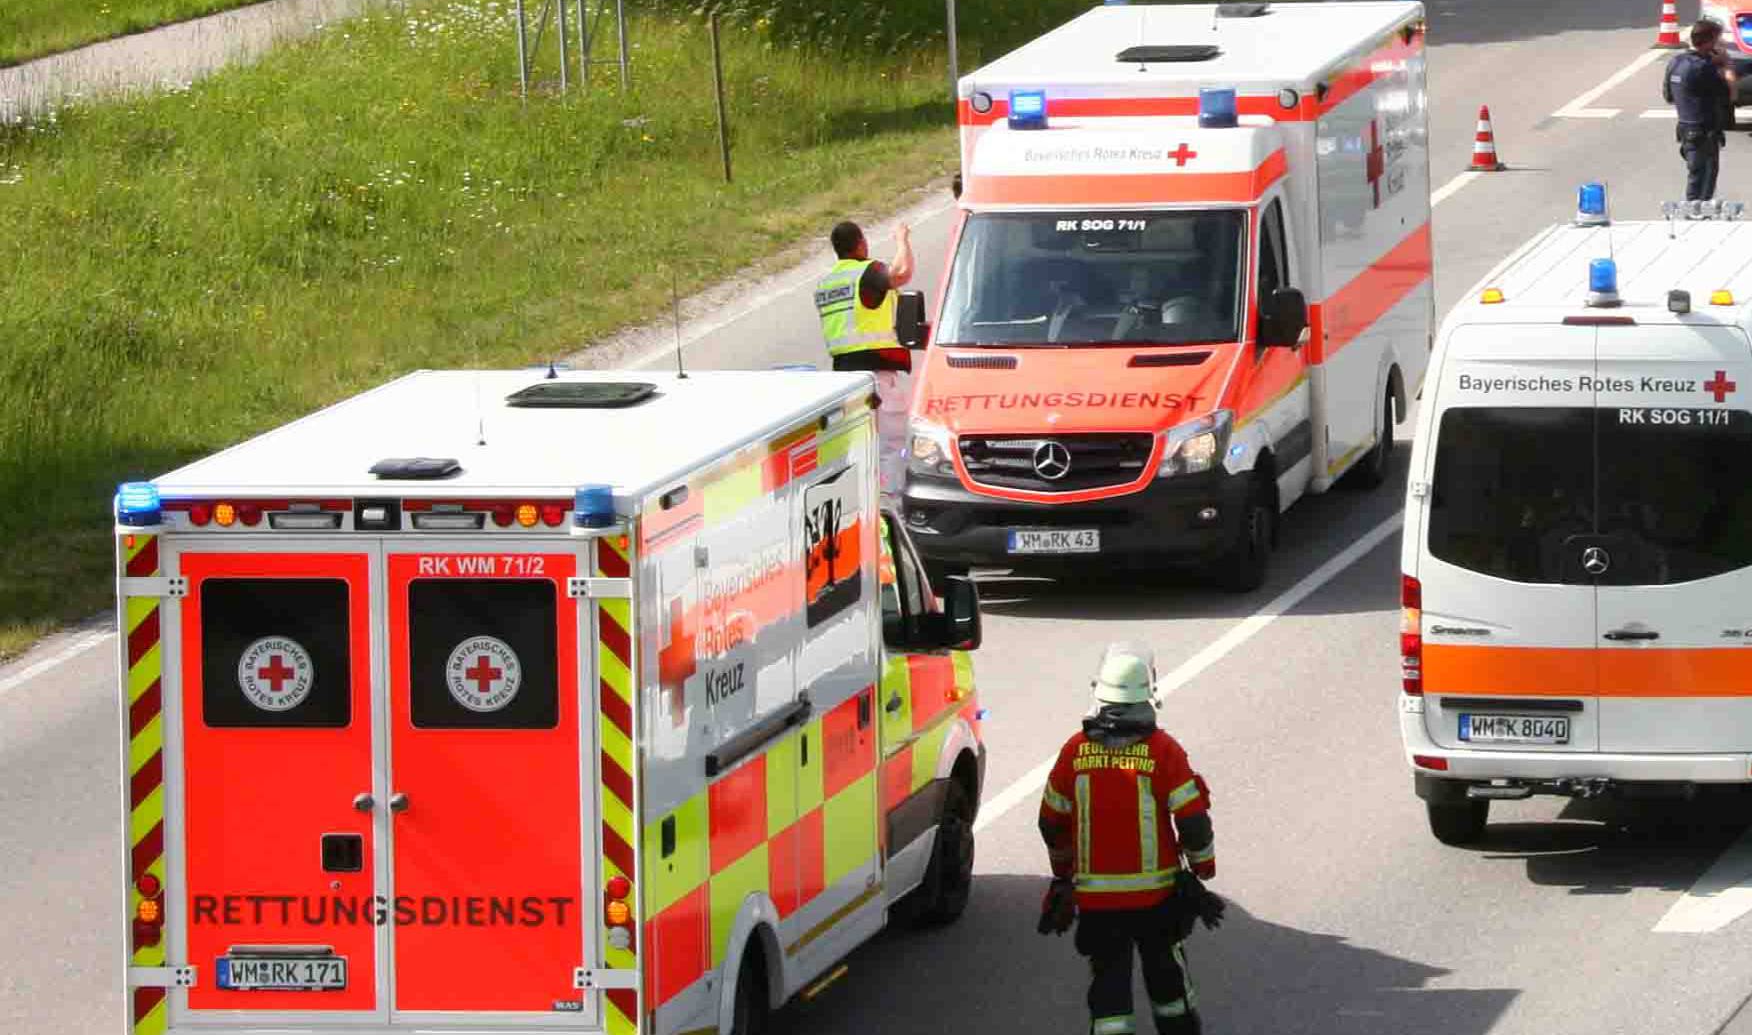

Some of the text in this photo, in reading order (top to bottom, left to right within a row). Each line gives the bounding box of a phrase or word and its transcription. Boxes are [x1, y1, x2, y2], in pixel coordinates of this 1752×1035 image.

[1055, 219, 1147, 232] RK SOG 71/1
[1459, 375, 1696, 394] Bayerisches Rotes Kreuz
[925, 391, 1205, 415] RETTUNGSDIENST
[1619, 408, 1730, 425] RK SOG 11/1
[1051, 532, 1071, 547] RK
[1075, 531, 1094, 546] 43
[419, 556, 545, 575] RK WM 71/2
[244, 640, 308, 671] BAYERISCHES
[452, 640, 516, 671] BAYERISCHES
[705, 663, 745, 709] Kreuz
[1472, 717, 1495, 737] WM
[1522, 719, 1566, 738] 8040
[193, 895, 574, 928] RETTUNGSDIENST
[231, 962, 343, 984] WM RK 171
